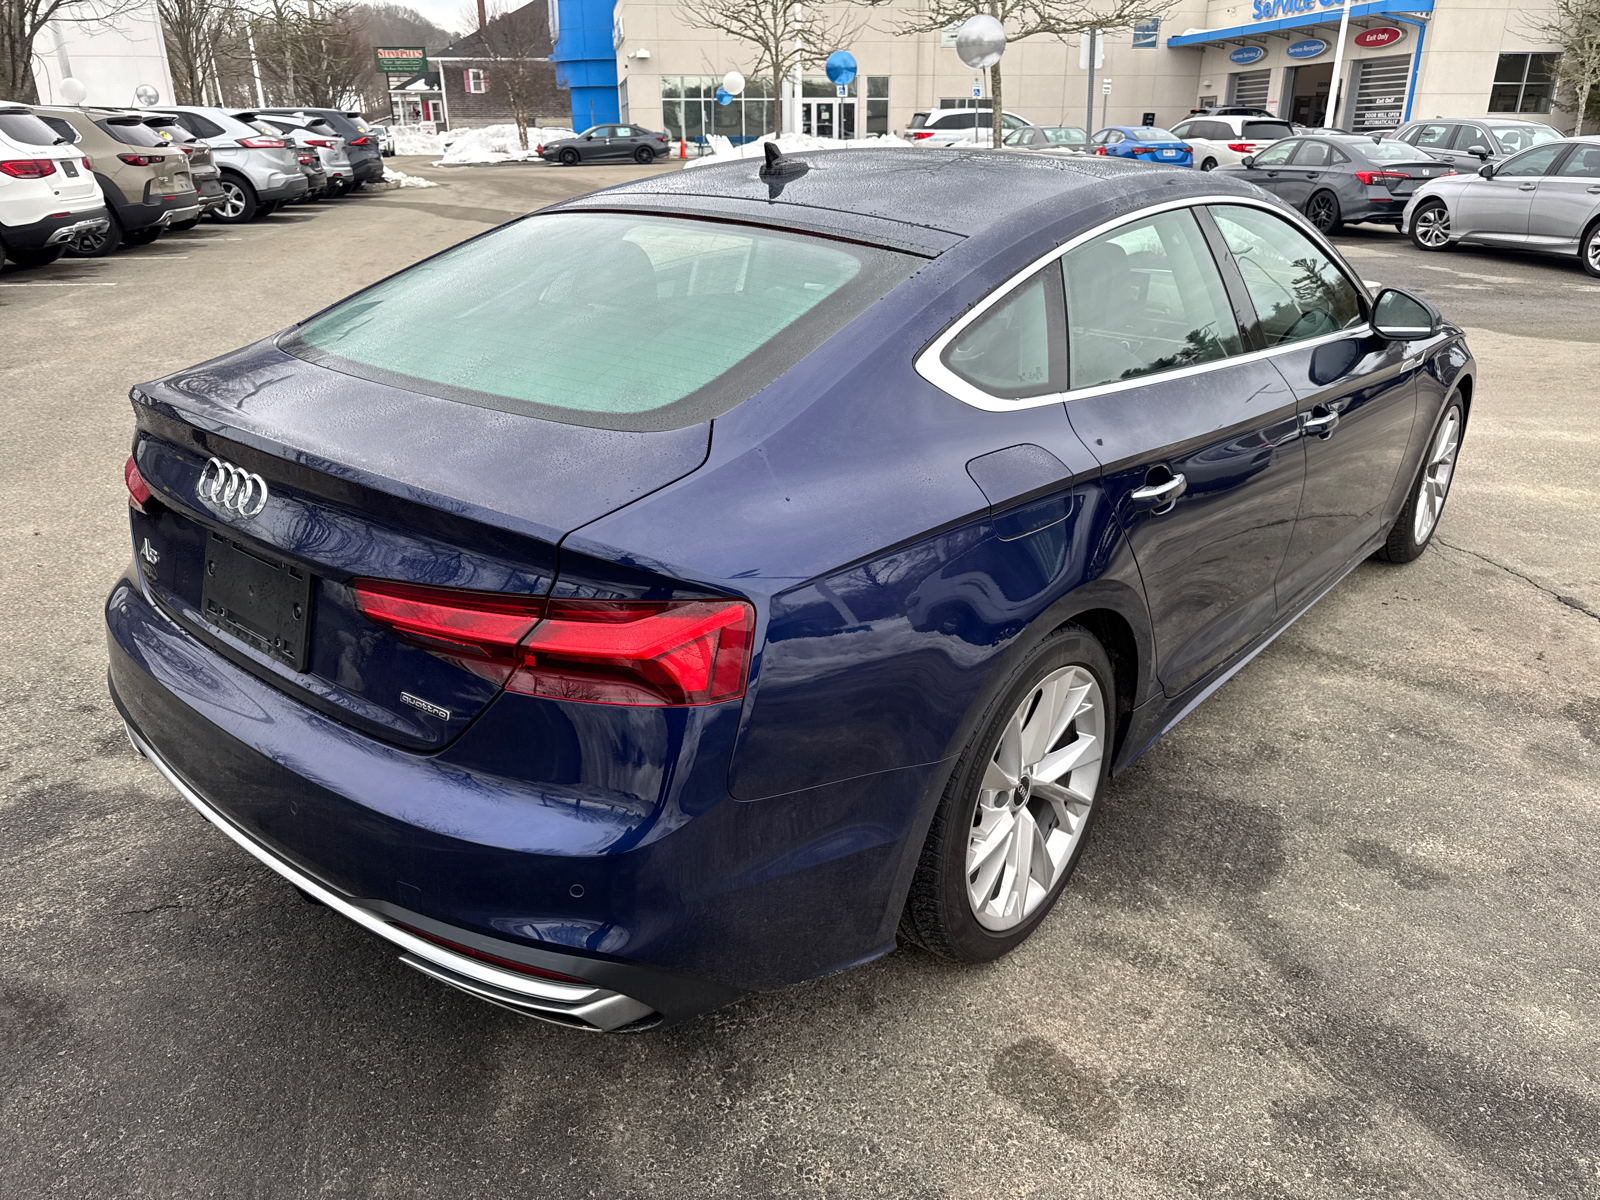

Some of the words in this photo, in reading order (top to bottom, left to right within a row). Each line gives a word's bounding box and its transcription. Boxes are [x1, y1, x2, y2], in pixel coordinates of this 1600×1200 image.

[1252, 0, 1312, 19] Service
[1366, 34, 1377, 42] Exit
[1377, 33, 1389, 41] Only
[1288, 46, 1303, 54] Service
[140, 537, 160, 565] A5
[401, 694, 447, 718] quattro
